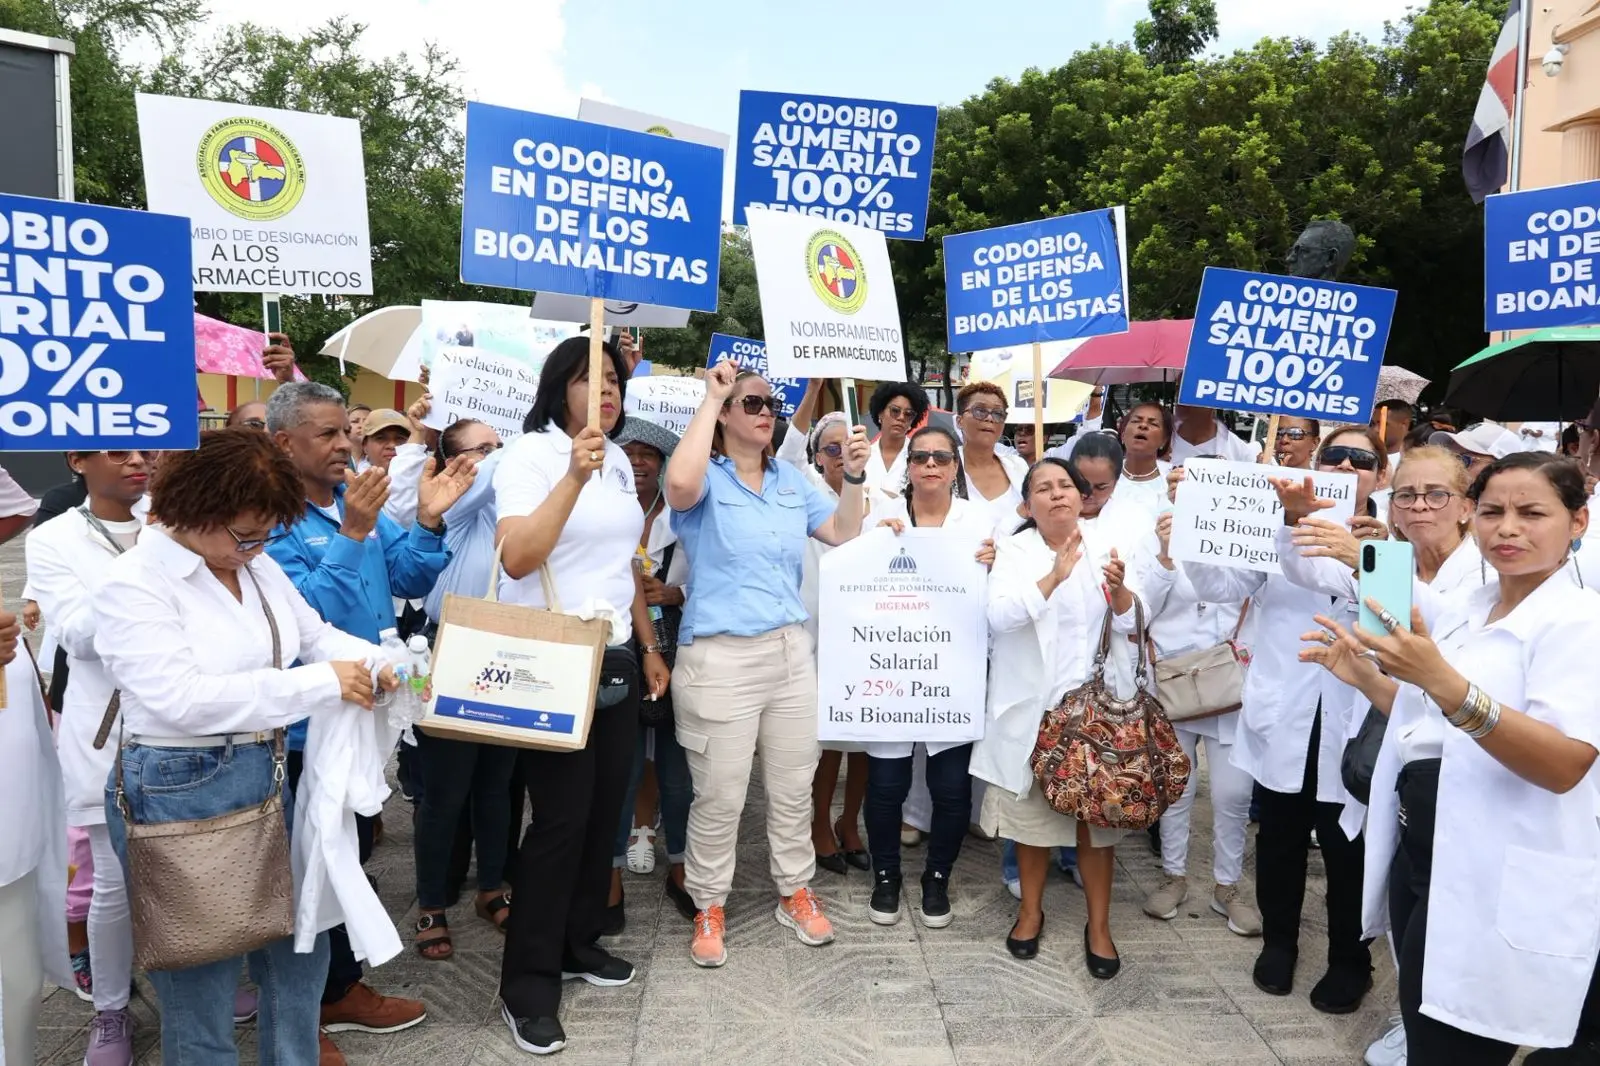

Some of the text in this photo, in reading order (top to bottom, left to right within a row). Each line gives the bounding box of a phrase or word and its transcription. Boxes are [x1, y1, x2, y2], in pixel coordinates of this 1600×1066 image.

[781, 100, 897, 130] CODOBIO
[752, 123, 921, 156] AUMENTO
[513, 138, 673, 193] CODOBIO,
[753, 145, 917, 178] SALARIAL
[491, 165, 691, 223] EN DEFENSA
[772, 170, 894, 210] 100%
[0, 211, 109, 256] BIO
[536, 205, 649, 247] DE LOS
[1527, 206, 1600, 234] COD
[233, 229, 253, 241] DE
[258, 230, 358, 246] DESIGNACIÓN
[973, 231, 1088, 267] CODOBIO,
[1508, 237, 1549, 263] EN
[211, 243, 279, 263] A LOS
[474, 228, 708, 285] BIOANALISTAS
[961, 252, 1104, 291] EN DEFENSA
[1550, 258, 1593, 284] DE
[992, 279, 1073, 308] DE LOS
[1243, 279, 1358, 309] CODOBIO
[1496, 284, 1600, 314] BIOAN
[954, 294, 1121, 335] BIOANALISTAS
[1209, 300, 1376, 340] AUMENTO
[790, 320, 900, 343] NOMBRAMIENTO
[1207, 324, 1369, 363] SALARIAL
[441, 352, 513, 378] Nivelación
[793, 345, 898, 363] DE FARMACÉUTICOS
[1225, 349, 1344, 392] 100%
[445, 391, 462, 406] las
[459, 377, 536, 404] y 25% Para
[1196, 379, 1360, 416] PENSIONES
[638, 399, 655, 412] las
[1210, 497, 1221, 511] y
[1227, 496, 1265, 514] 25%
[1194, 515, 1217, 531] las
[1200, 539, 1223, 555] De
[899, 584, 967, 595] DOMINICANA
[875, 601, 930, 611] DIGEMAPS
[852, 626, 951, 643] Nivelación
[483, 667, 511, 685] XXI
[844, 680, 951, 700] y 25% Para
[829, 706, 971, 724] las Bioanalistas
